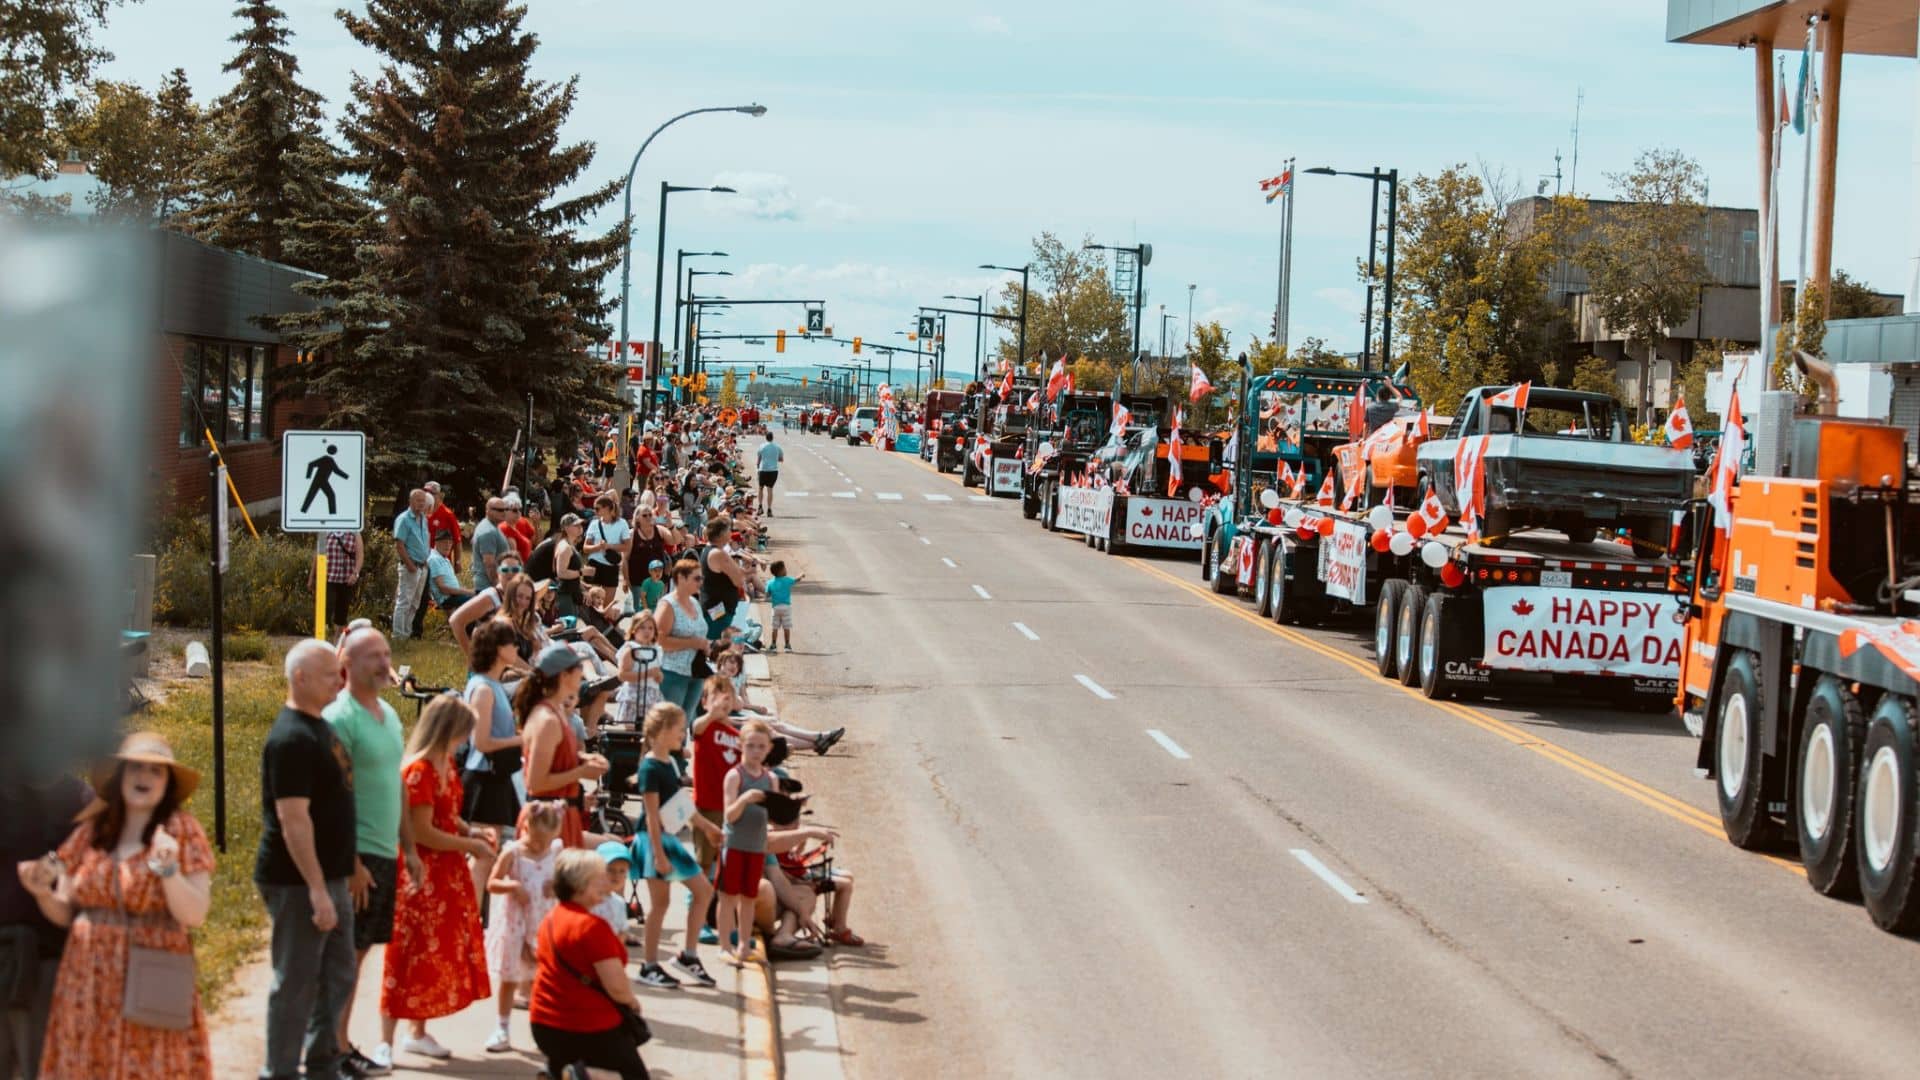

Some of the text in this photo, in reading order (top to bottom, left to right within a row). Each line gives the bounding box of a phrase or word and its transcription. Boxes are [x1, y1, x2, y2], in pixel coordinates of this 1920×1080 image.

[1162, 505, 1206, 523] HAPP
[1552, 596, 1662, 629] HAPPY
[1497, 629, 1681, 667] CANADA DA
